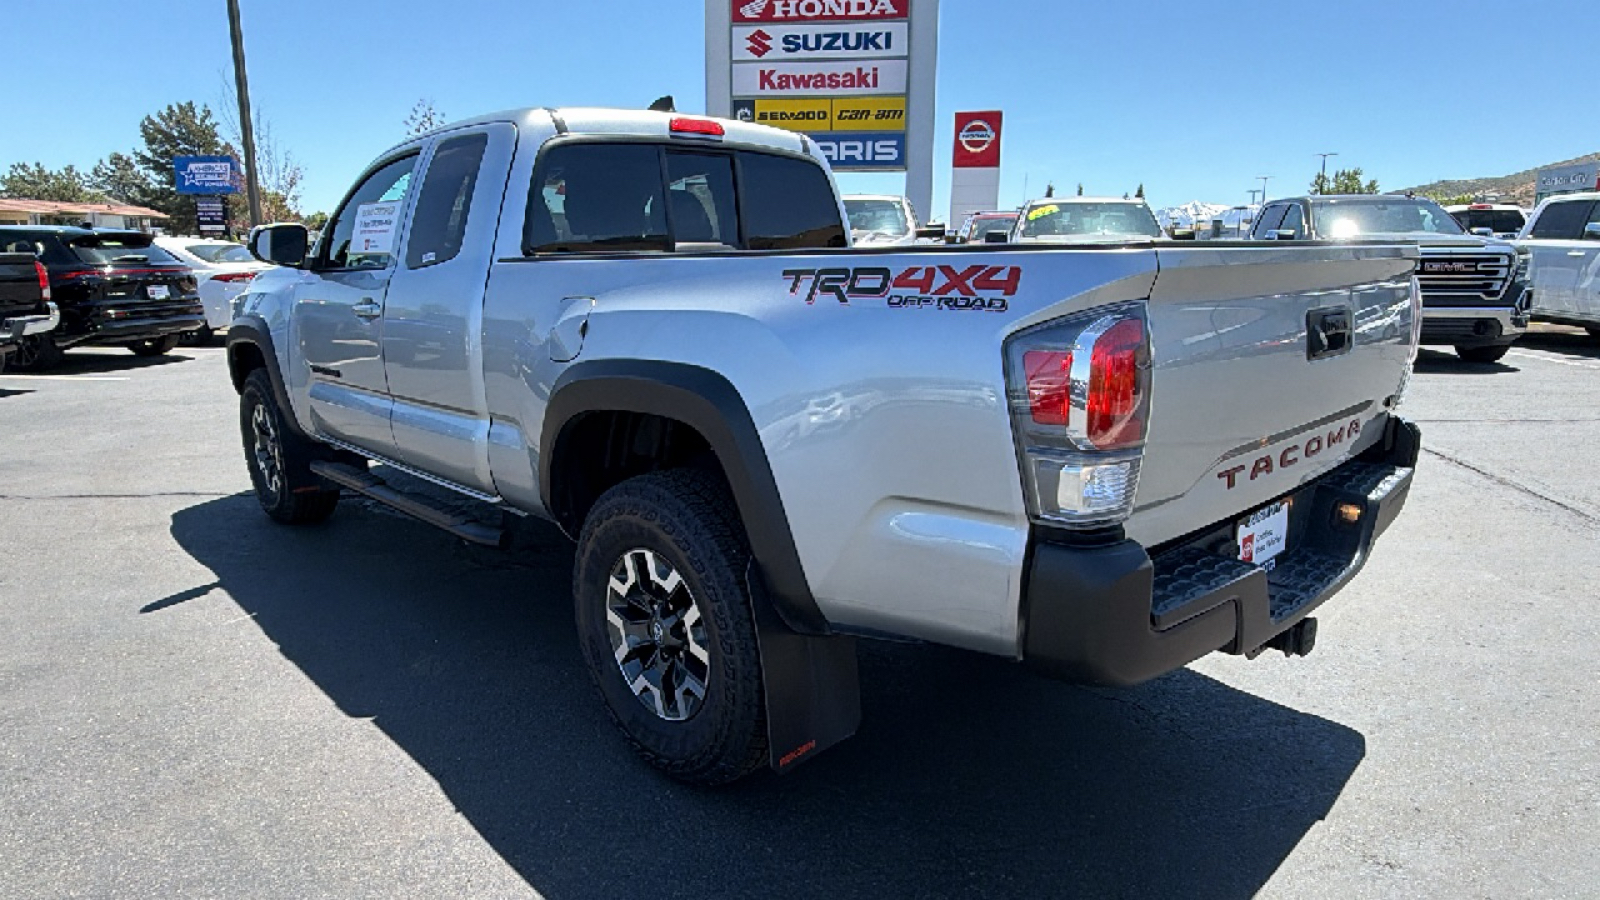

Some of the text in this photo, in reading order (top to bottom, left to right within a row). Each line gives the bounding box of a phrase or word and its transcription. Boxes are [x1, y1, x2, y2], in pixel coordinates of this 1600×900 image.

[772, 0, 898, 18] HONDA
[782, 32, 892, 53] SUZUKI
[759, 67, 879, 90] Kawasaki
[819, 140, 899, 161] ARIS
[1569, 173, 1588, 185] City
[1424, 262, 1476, 271] GMC
[782, 265, 1022, 306] TRD 4X4
[887, 294, 1009, 312] OFF ROAD
[1217, 418, 1361, 490] TACOMA
